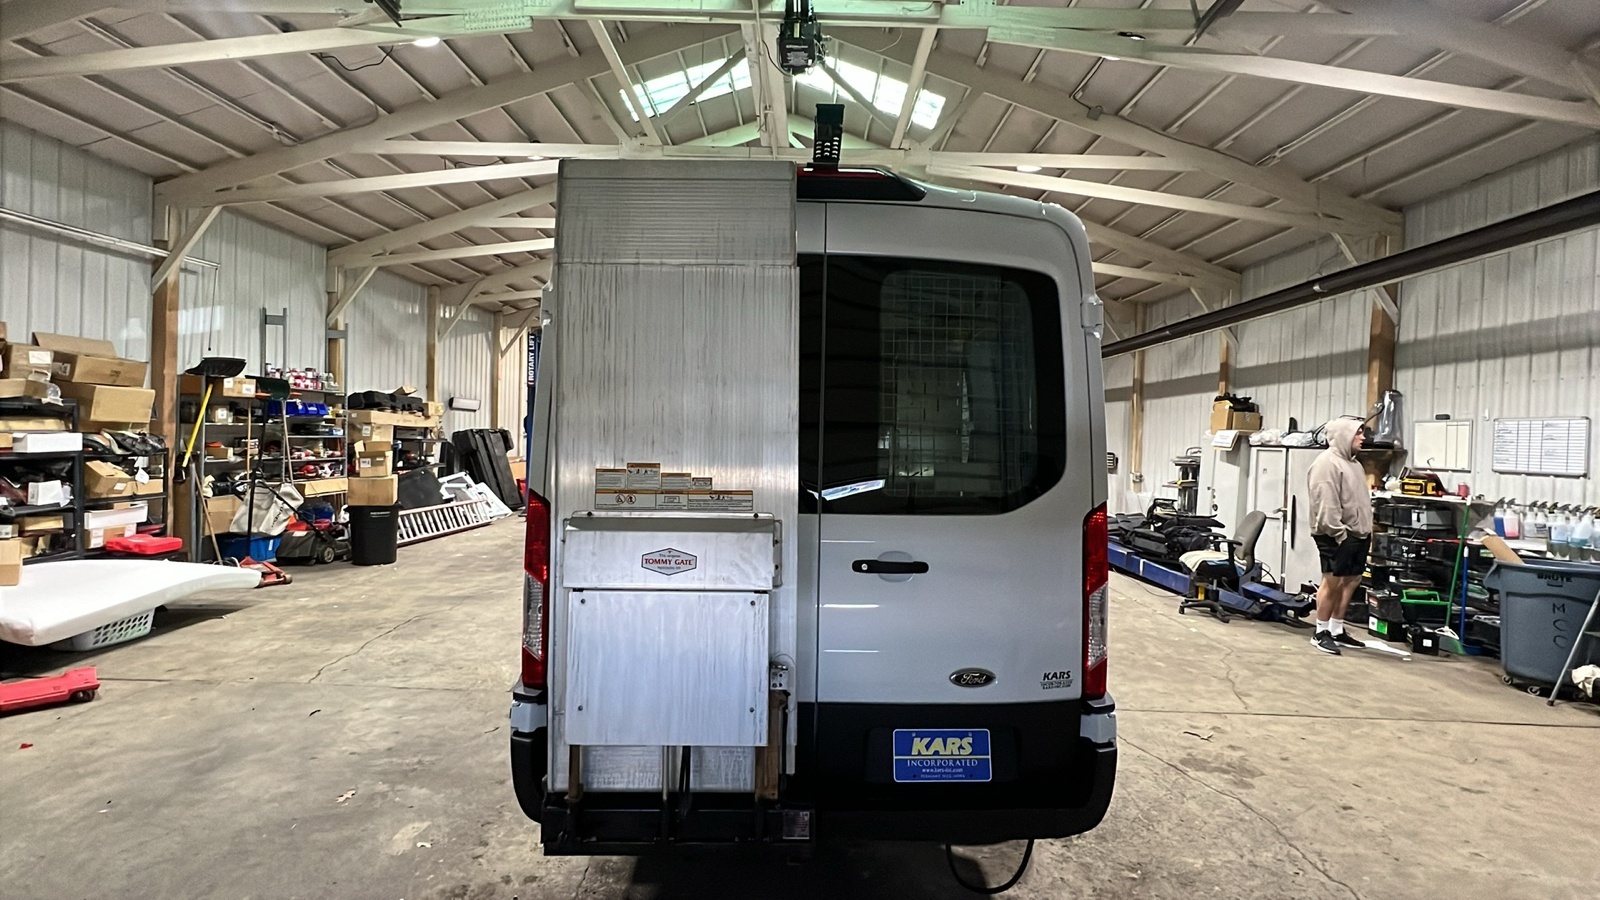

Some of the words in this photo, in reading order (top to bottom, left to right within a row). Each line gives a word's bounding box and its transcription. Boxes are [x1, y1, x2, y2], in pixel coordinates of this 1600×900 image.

[960, 672, 987, 684] Ford
[1042, 670, 1072, 681] KARS
[911, 736, 973, 755] KARS
[907, 759, 978, 767] INCORPORATED
